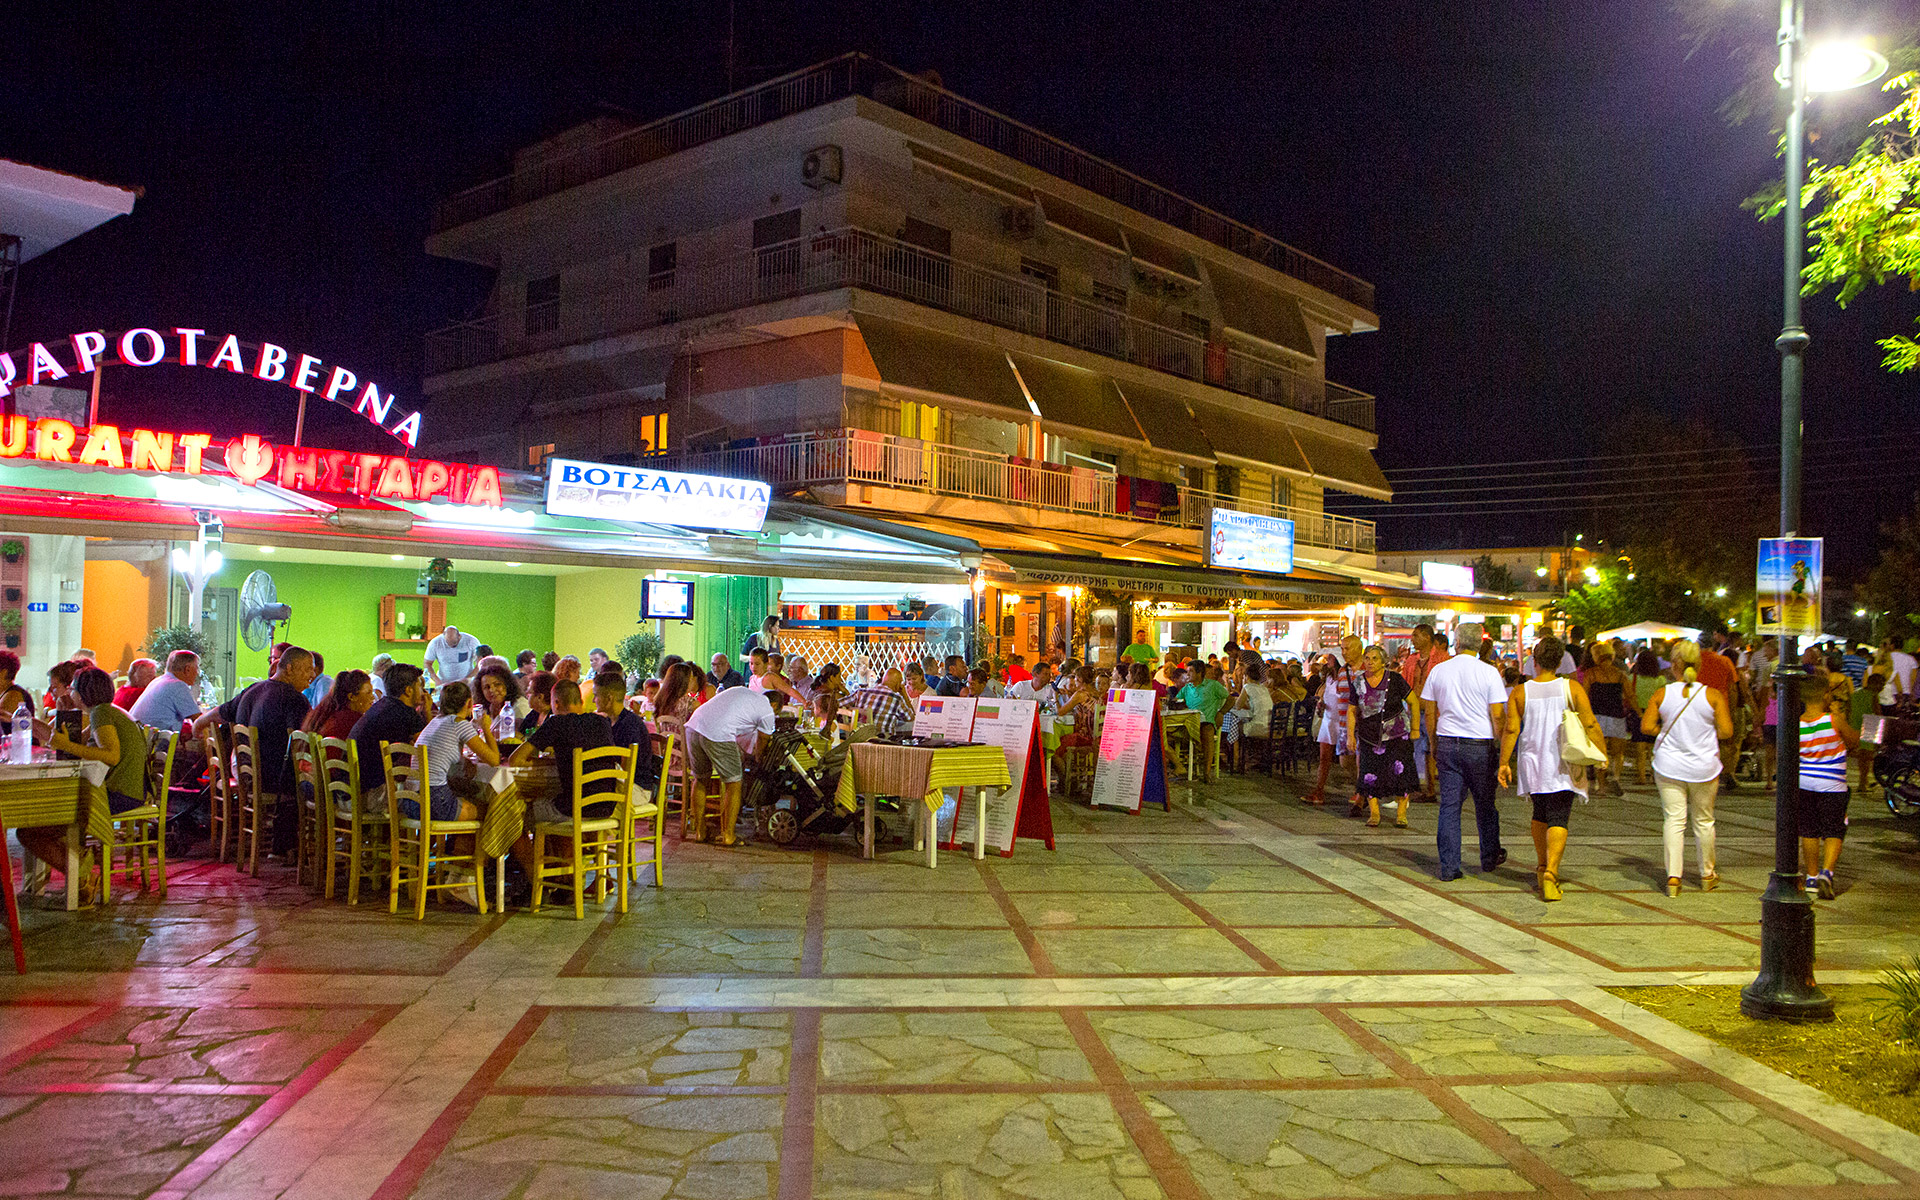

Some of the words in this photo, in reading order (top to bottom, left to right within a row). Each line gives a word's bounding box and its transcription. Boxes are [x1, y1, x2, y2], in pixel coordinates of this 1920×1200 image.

[0, 413, 213, 475] URANT
[224, 433, 503, 507] ΨΗΣΤΑΡΙΑ
[561, 464, 768, 504] ΒΟΤΣΑΛΑΚΙΑ
[1117, 579, 1164, 593] ΨΗΣΤΑΡΙΑ
[1181, 583, 1193, 594] ΤΟ
[1197, 586, 1237, 599] ΚΟΥΤΟΥΚΙ
[1243, 590, 1258, 600] ΤΟΥ
